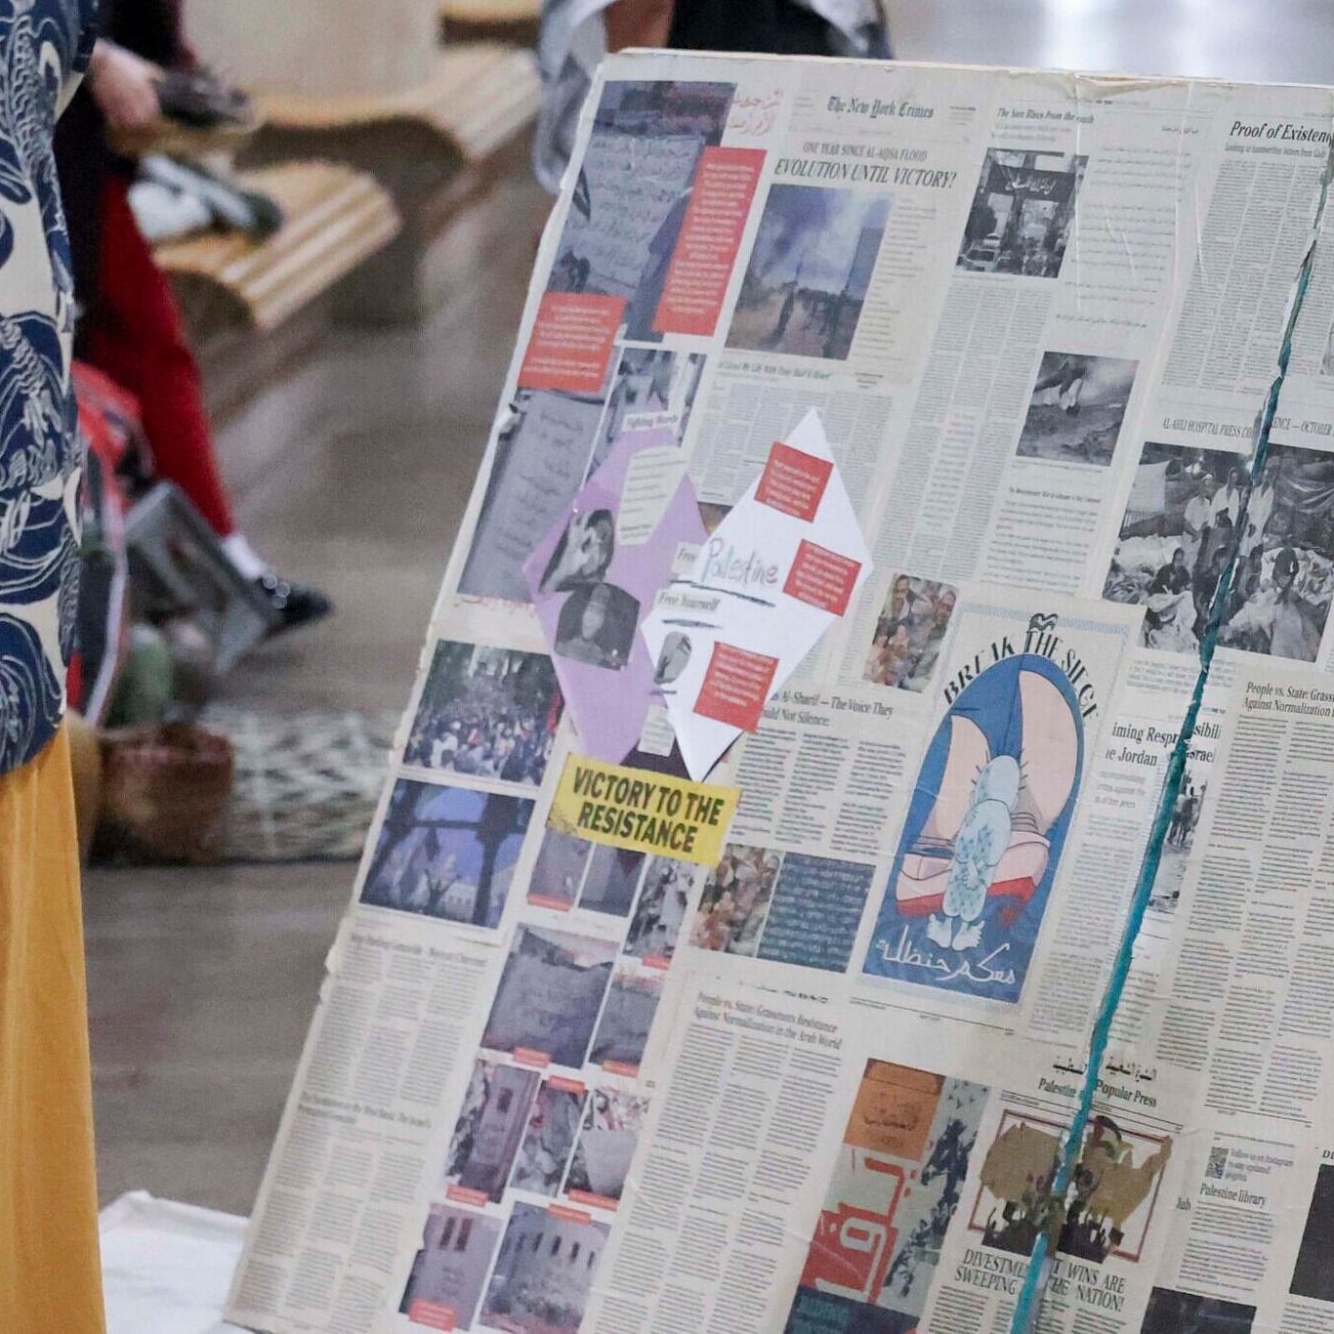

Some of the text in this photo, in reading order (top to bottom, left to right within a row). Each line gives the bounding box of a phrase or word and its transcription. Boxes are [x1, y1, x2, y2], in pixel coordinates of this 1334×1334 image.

[1229, 121, 1267, 138] Proof
[1267, 123, 1283, 138] of
[851, 164, 888, 183] UNTIL
[893, 167, 957, 189] VICTORY!
[1246, 682, 1273, 698] People
[1287, 685, 1309, 699] State:
[1243, 697, 1273, 712] Against
[1274, 699, 1330, 716] Normalization
[1119, 747, 1158, 766] Jordan
[573, 767, 725, 826] VICTORY TO THE
[577, 801, 698, 853] RESISTANCE
[1096, 1079, 1157, 1108] Popular Press
[1199, 1182, 1266, 1209] Palestine library
[955, 1265, 1125, 1313] SWEEPING NATION!
[1068, 1262, 1127, 1294] WINS ARE
